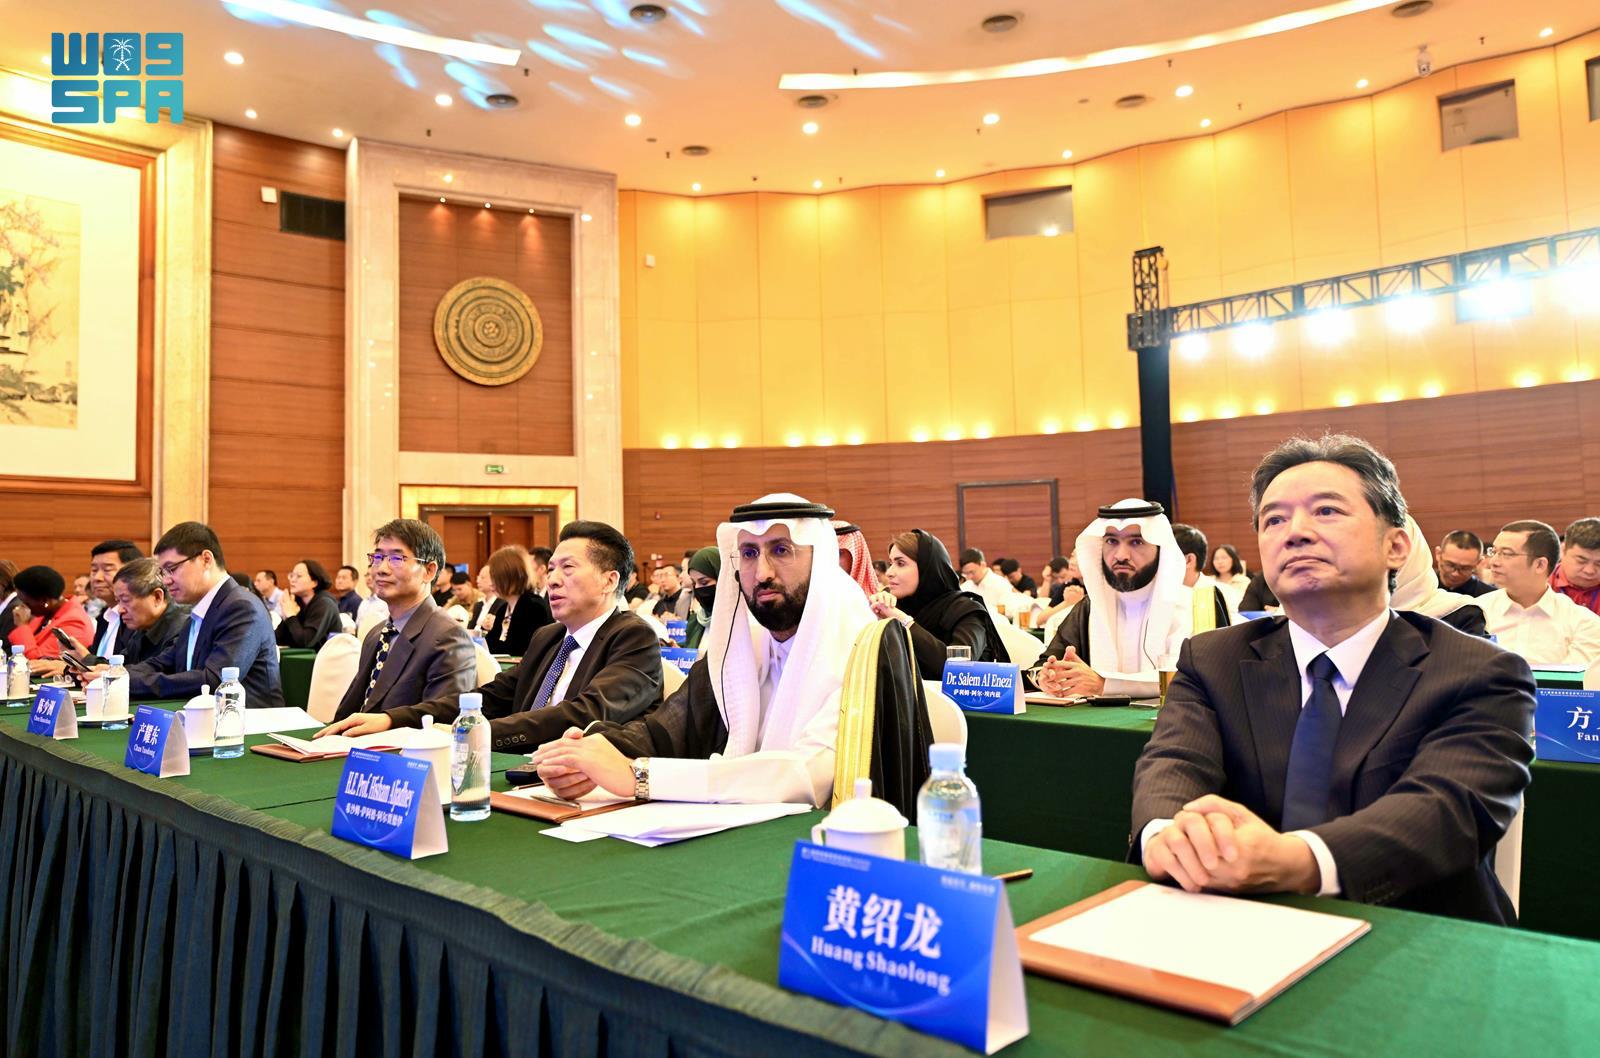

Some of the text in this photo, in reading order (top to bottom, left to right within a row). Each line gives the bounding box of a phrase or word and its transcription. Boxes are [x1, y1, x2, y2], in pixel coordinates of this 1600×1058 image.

[947, 672, 1012, 689] Dr. Salem Al Enezi
[1566, 706, 1600, 730] 方
[823, 884, 943, 959] 黄绍龙
[811, 935, 951, 997] Huang Shaolong
